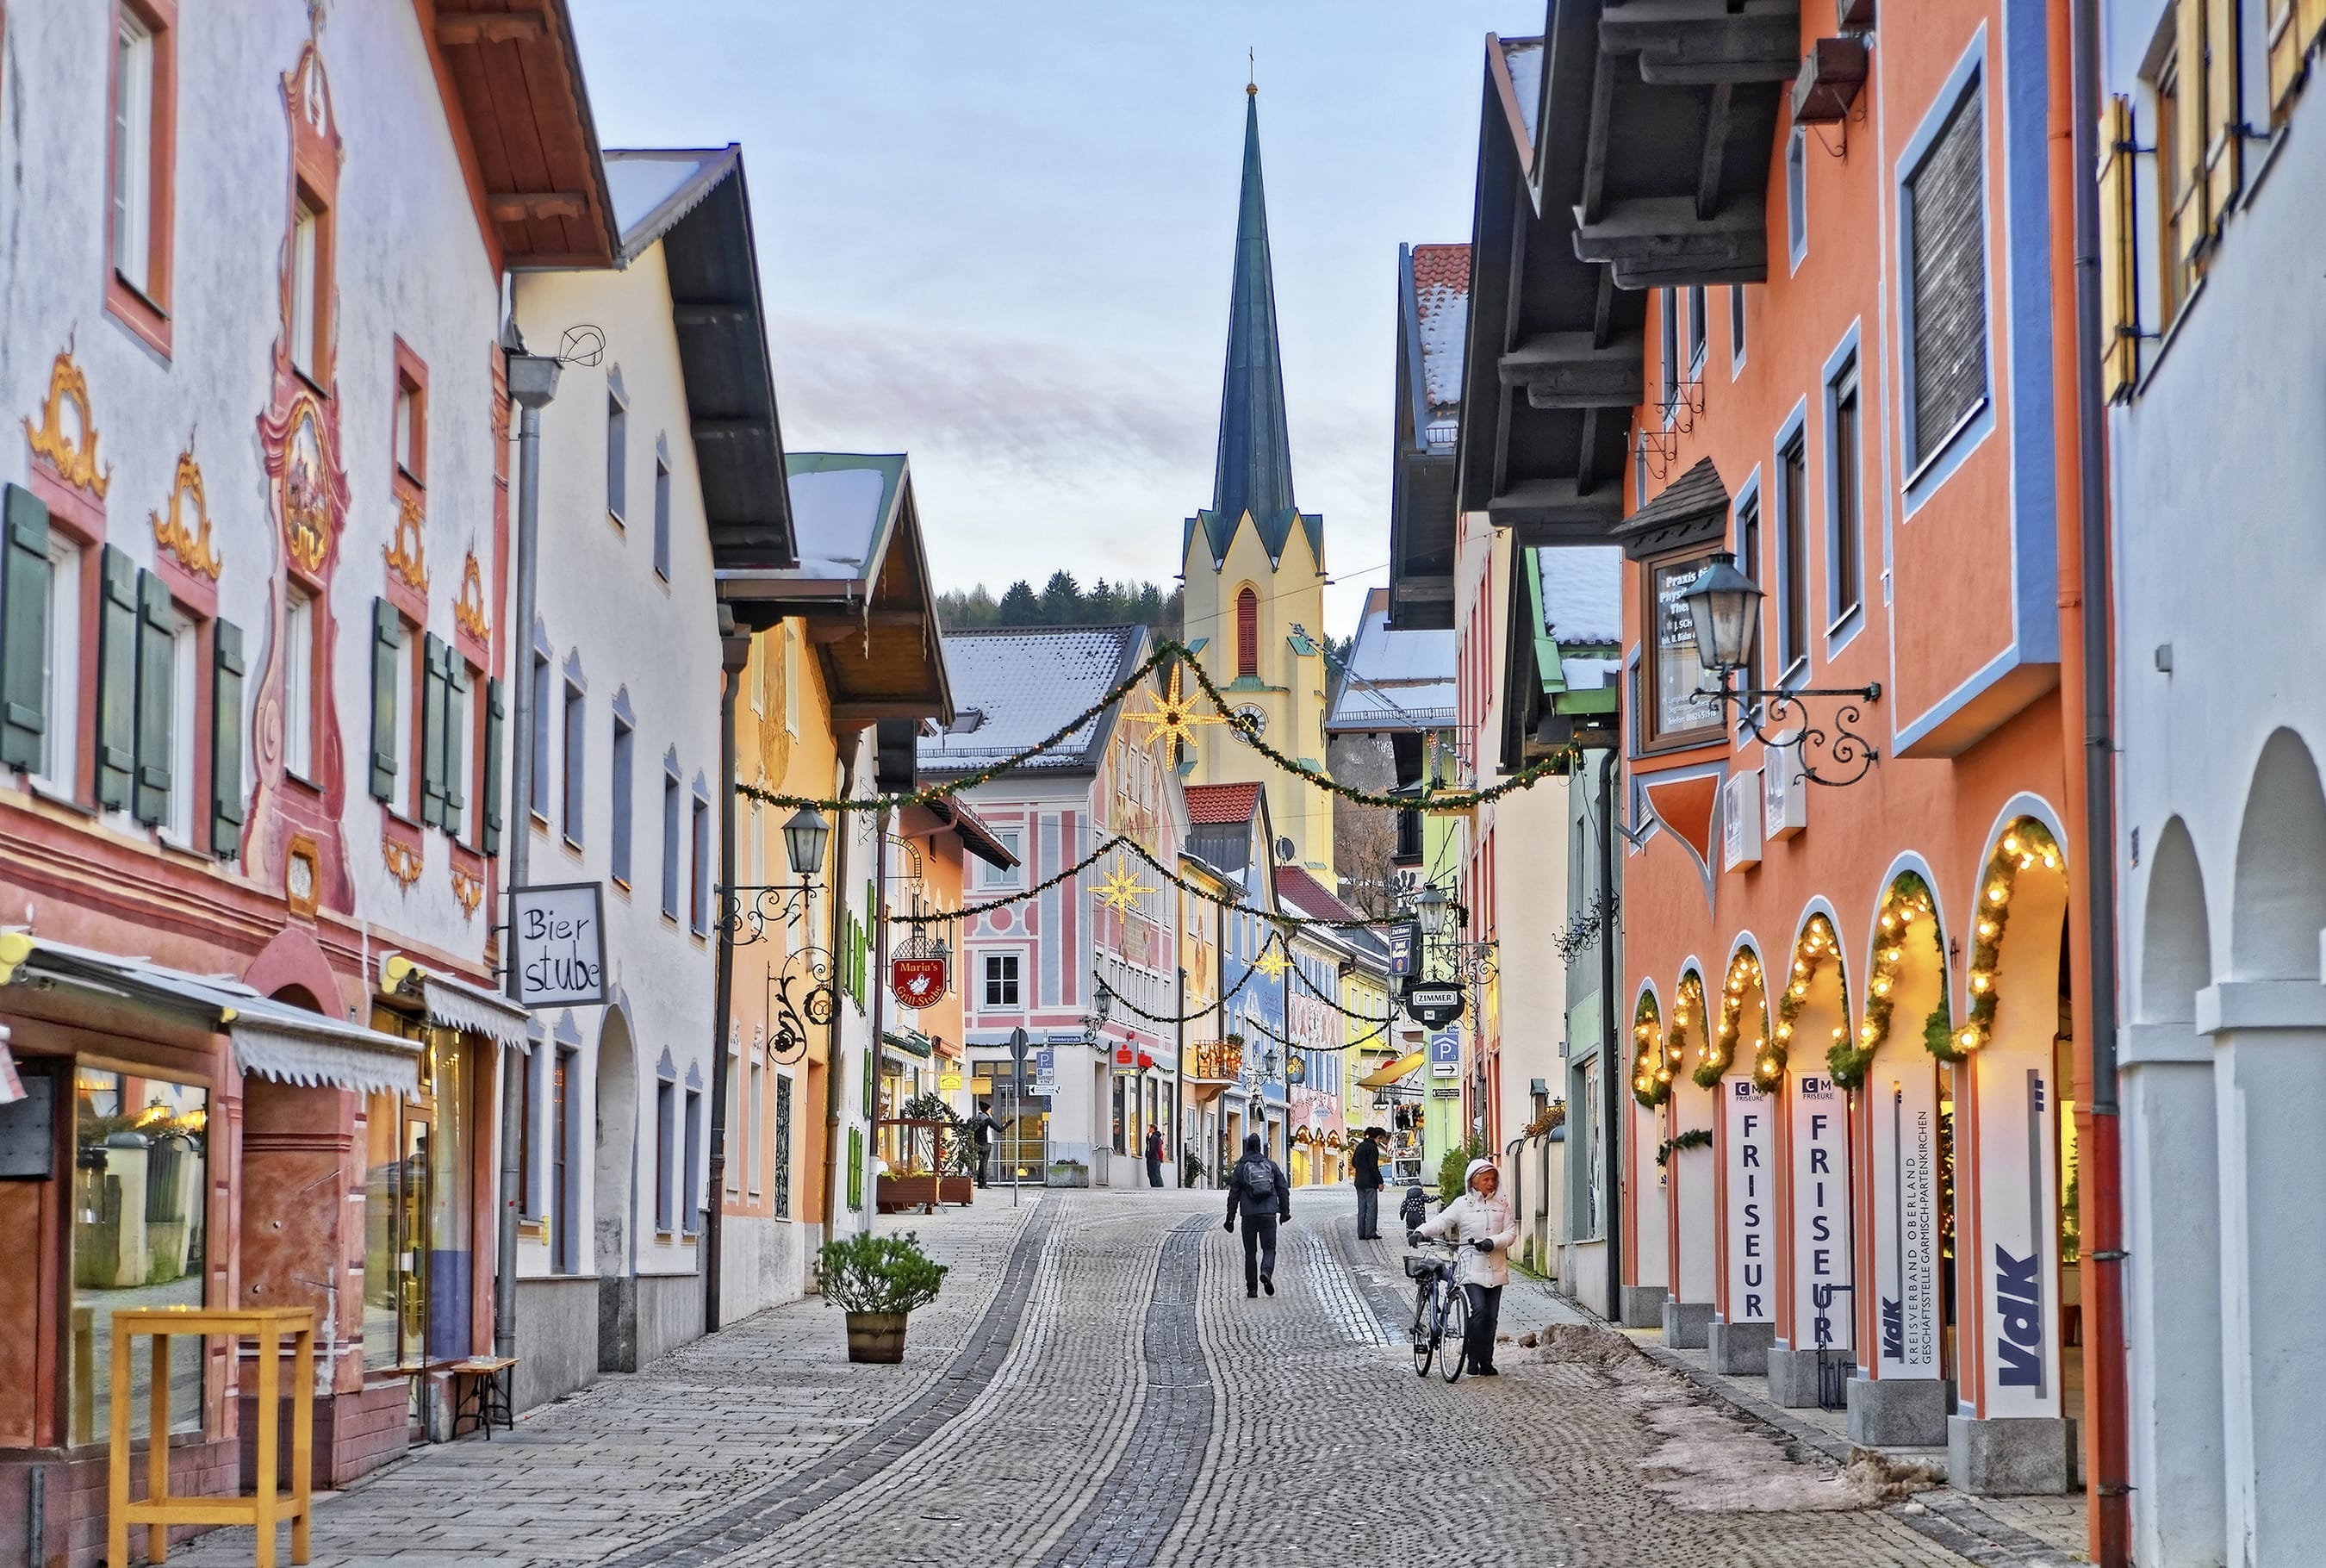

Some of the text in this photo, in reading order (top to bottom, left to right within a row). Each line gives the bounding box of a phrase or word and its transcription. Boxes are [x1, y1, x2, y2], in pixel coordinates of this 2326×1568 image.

[1666, 571, 1697, 588] Praxis
[524, 909, 589, 940] Bier
[525, 940, 600, 992] stube
[900, 962, 938, 972] Maria's
[897, 985, 942, 1006] Grill-Stube
[1040, 1054, 1049, 1067] P
[1440, 1043, 1452, 1060] P
[1742, 1115, 1763, 1317] FRISEUR
[1810, 1114, 1833, 1343] FRISEUR
[1918, 1111, 1931, 1365] GESCHÄFTSSTELLE GARMISCH-PARTENKIRCHEN
[1906, 1157, 1919, 1365] KREISVERBAND OBERLAND
[1882, 1296, 1902, 1359] VdK
[1995, 1243, 2042, 1386] VdK
